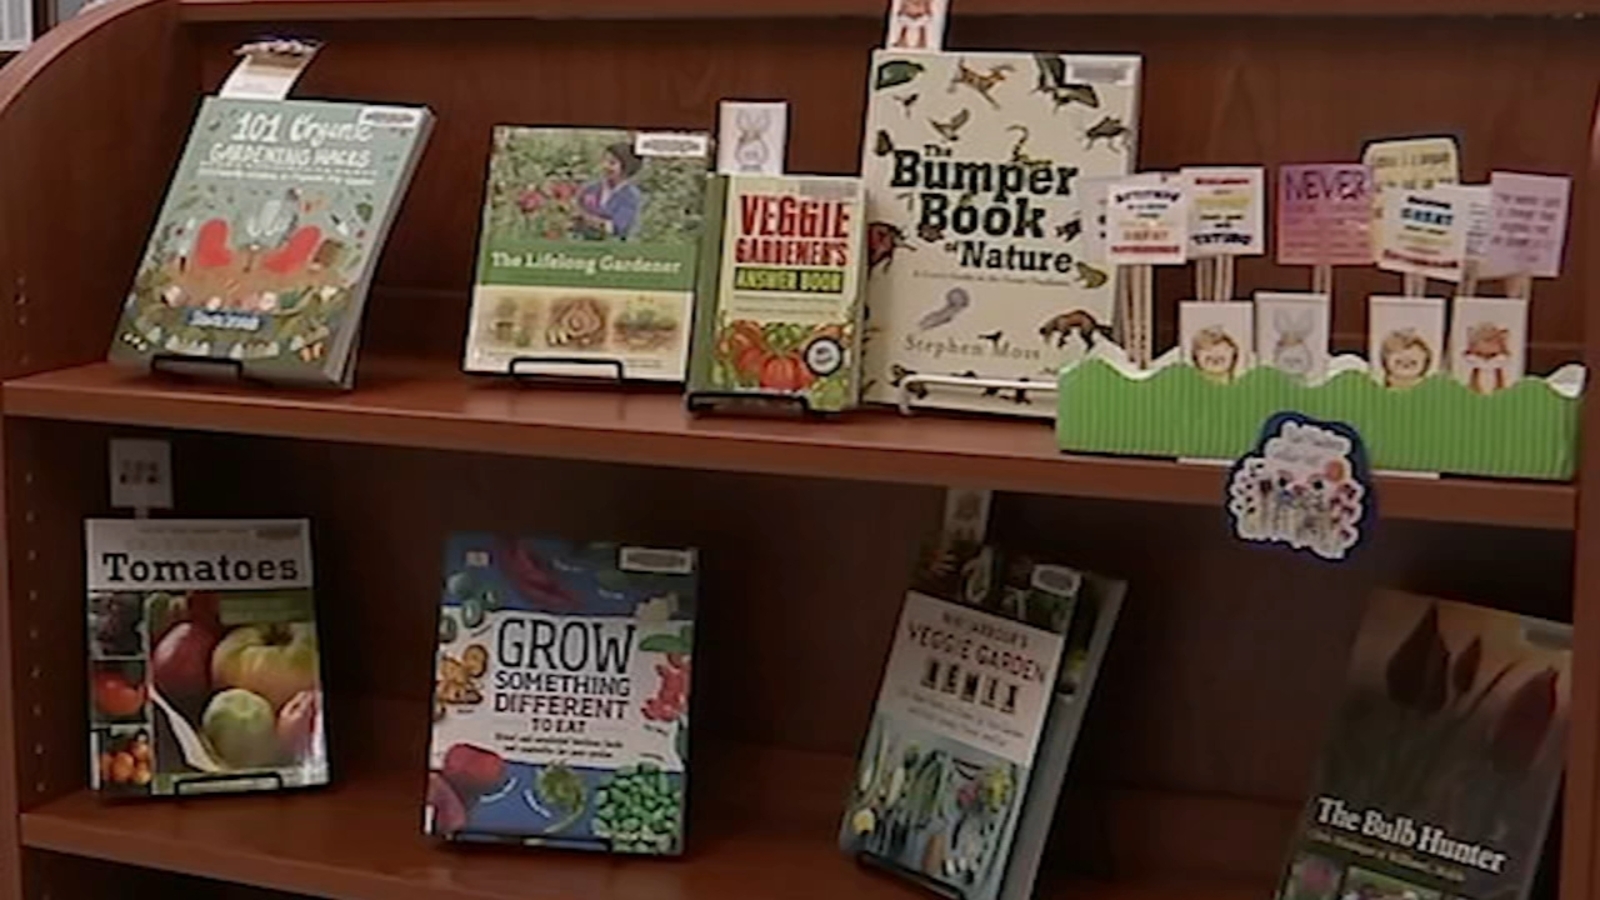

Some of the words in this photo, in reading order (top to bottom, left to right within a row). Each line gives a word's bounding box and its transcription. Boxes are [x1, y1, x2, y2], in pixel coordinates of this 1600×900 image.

[231, 111, 279, 142] 101
[891, 149, 1078, 203] Bumper
[1285, 170, 1365, 201] NEVER
[740, 194, 850, 239] VEGGIE
[918, 192, 1046, 240] Book
[491, 252, 522, 268] The
[525, 253, 597, 275] Lifelong
[600, 256, 681, 274] Gardener
[735, 237, 849, 267] GARDENER'S
[959, 240, 1074, 273] Nature
[736, 269, 799, 291] ANSWER
[800, 270, 842, 293] BOOK
[905, 333, 985, 359] Stephen
[103, 552, 299, 582] Tomatoes
[498, 617, 637, 674] GROW
[494, 671, 631, 697] SOMETHING
[494, 692, 631, 720] DIFFERENT
[532, 717, 551, 732] TO
[555, 718, 587, 733] EAT
[1317, 797, 1362, 831] The
[1361, 809, 1417, 847] Bulb
[1416, 826, 1508, 872] Hunter
